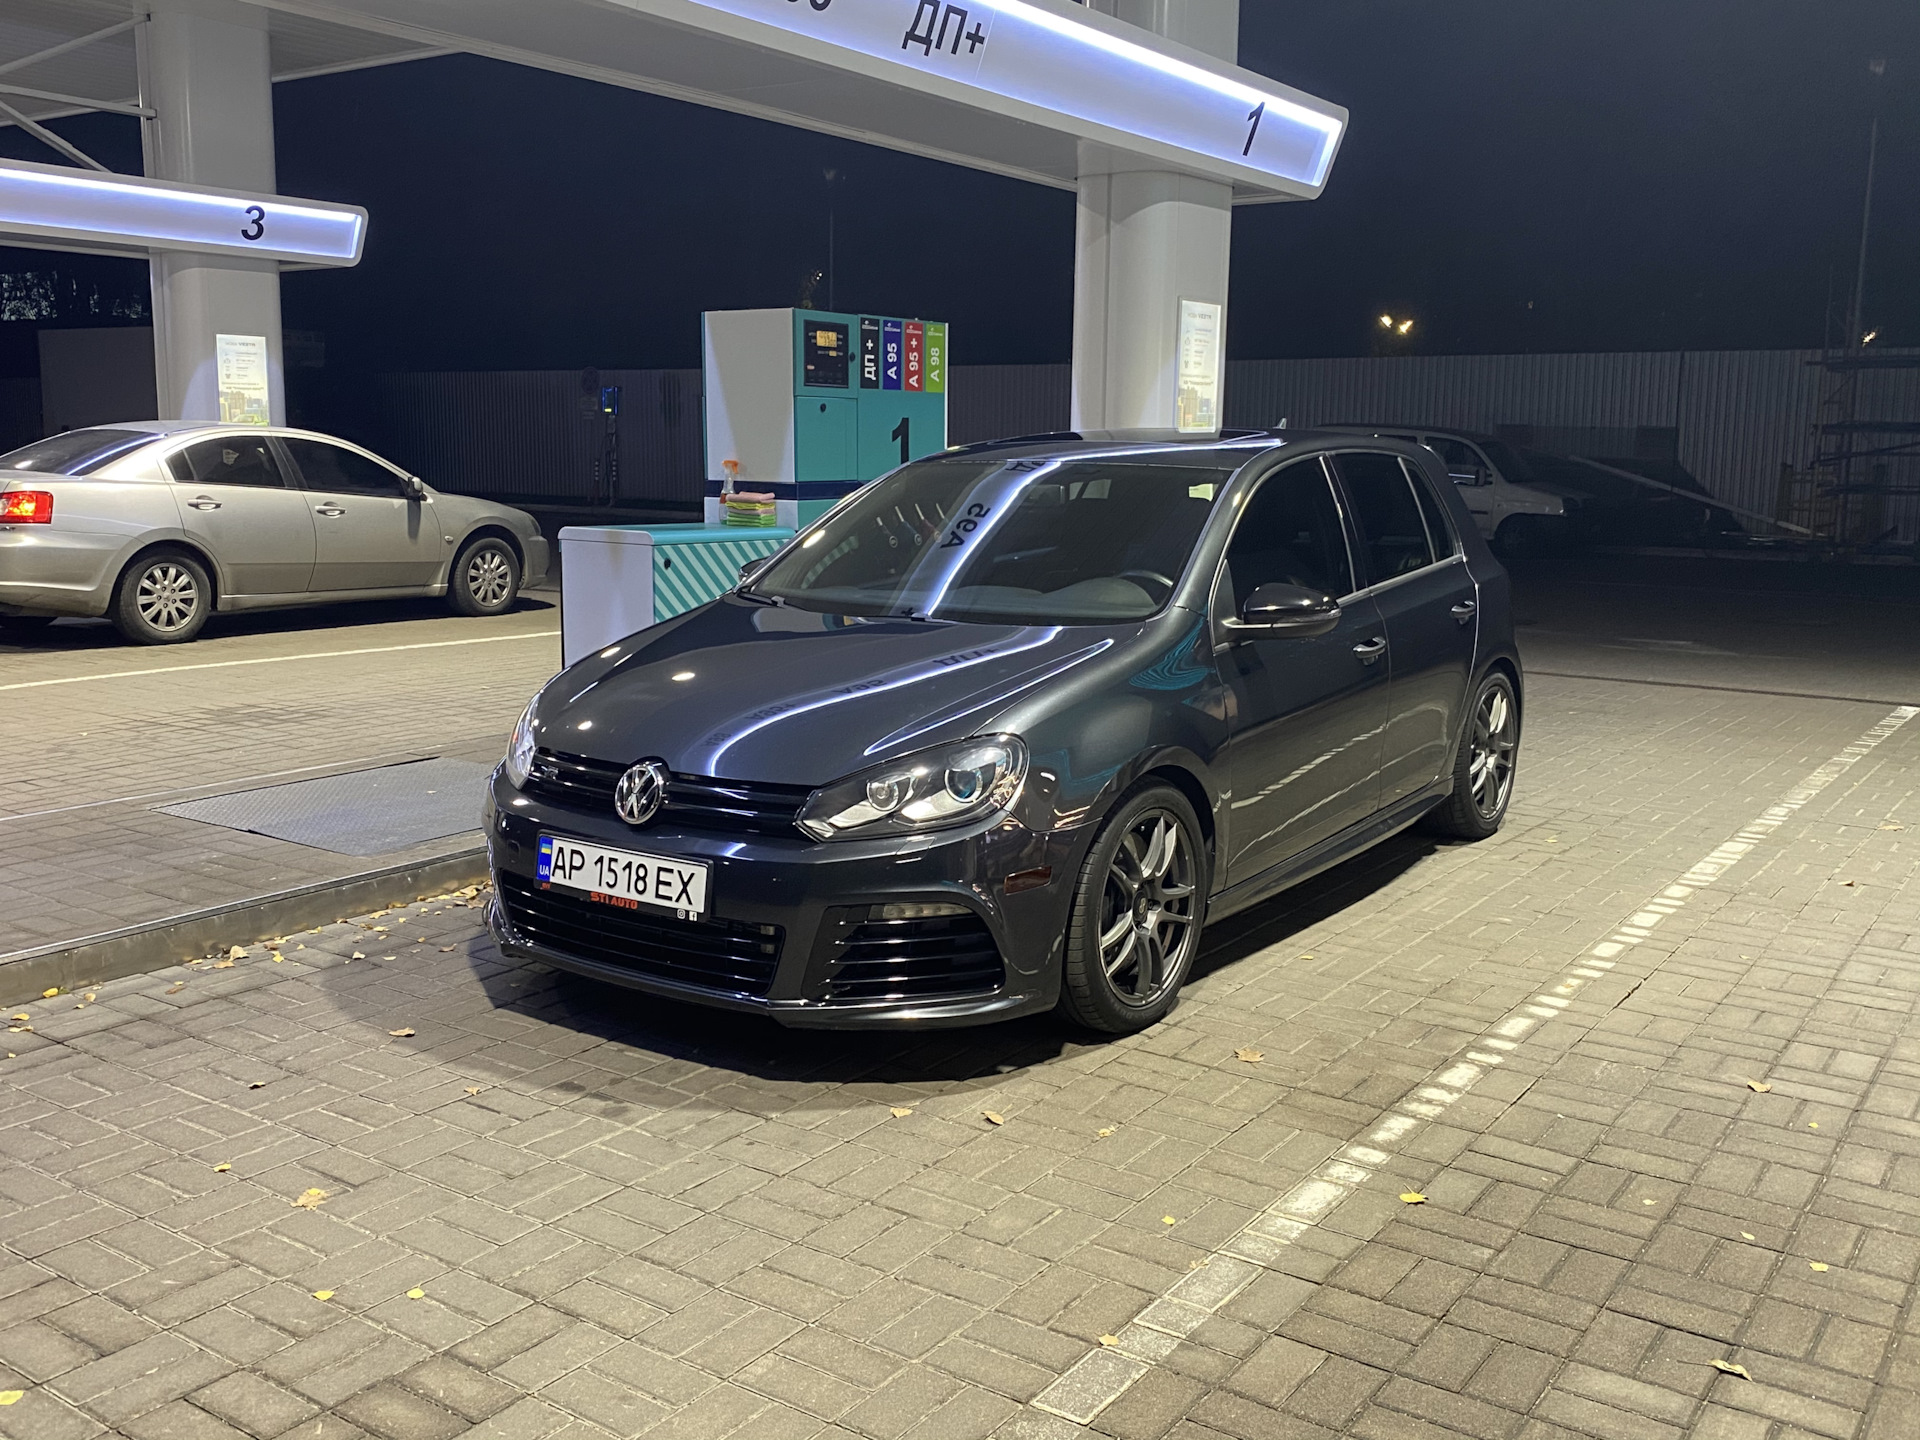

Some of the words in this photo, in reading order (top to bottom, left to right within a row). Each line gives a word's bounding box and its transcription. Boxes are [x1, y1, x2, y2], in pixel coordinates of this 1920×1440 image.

[1242, 101, 1265, 157] 1
[241, 205, 265, 241] 3
[887, 342, 898, 363] 95
[909, 351, 919, 371] 95
[930, 347, 940, 366] 98
[864, 354, 877, 381] ДП
[891, 417, 910, 464] 1
[539, 864, 550, 877] UA
[552, 846, 586, 881] AP
[593, 855, 649, 896] 1518
[655, 866, 696, 906] EX
[610, 897, 638, 910] AUTO
